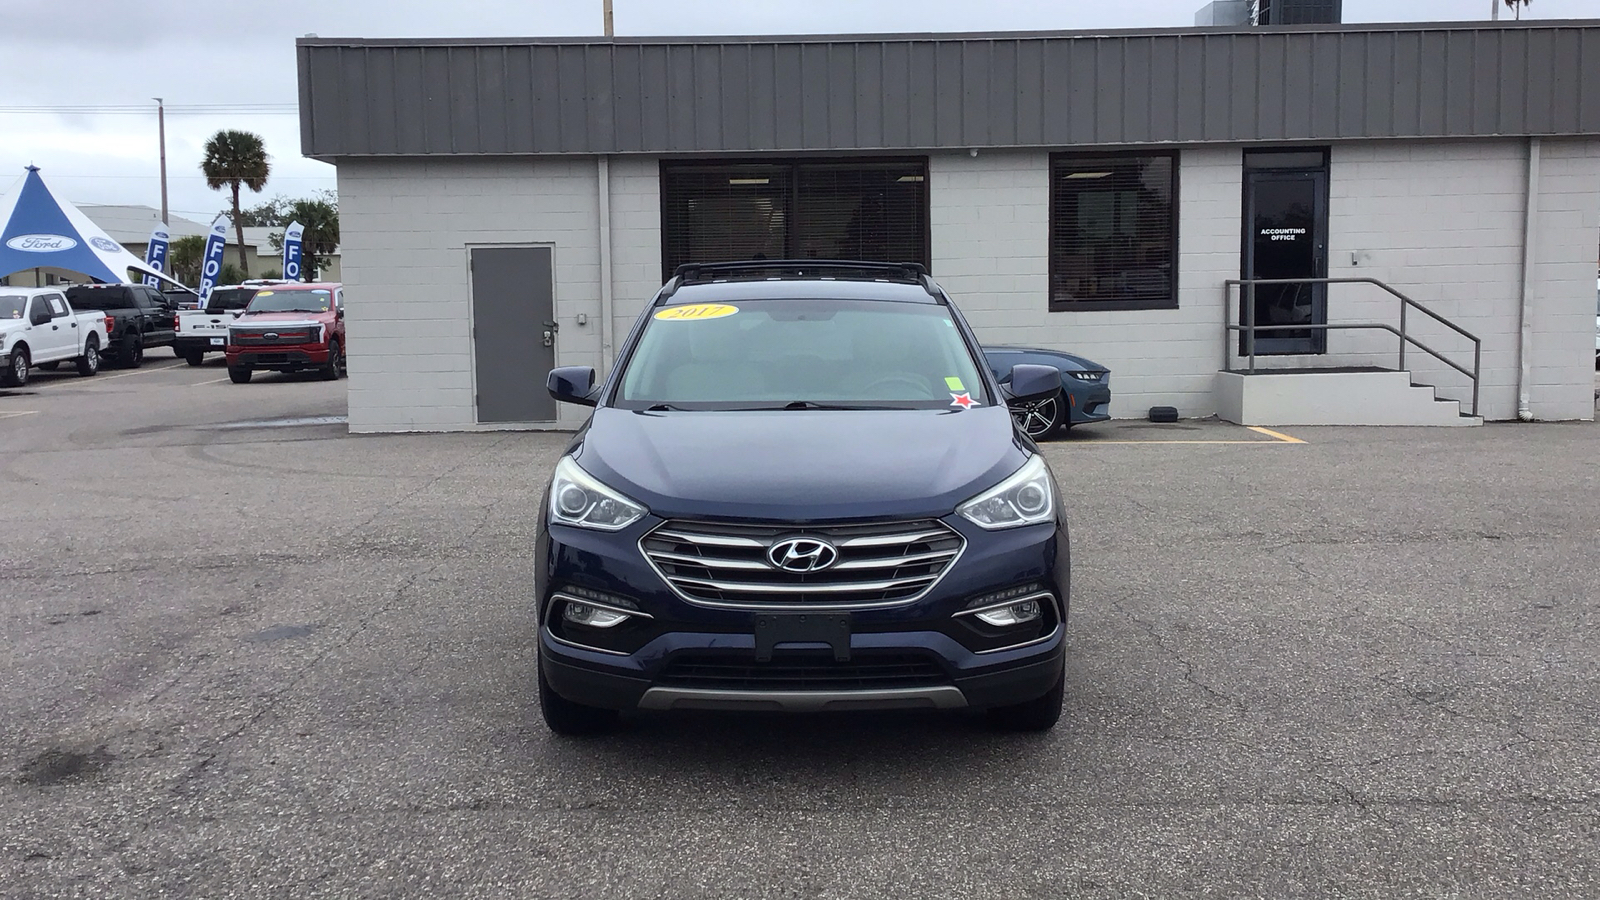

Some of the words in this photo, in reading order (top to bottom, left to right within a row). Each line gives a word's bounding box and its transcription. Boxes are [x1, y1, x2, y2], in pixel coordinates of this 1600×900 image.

[21, 237, 62, 249] Ford
[147, 244, 164, 289] FOR
[286, 245, 299, 277] FO
[667, 306, 725, 318] 2017
